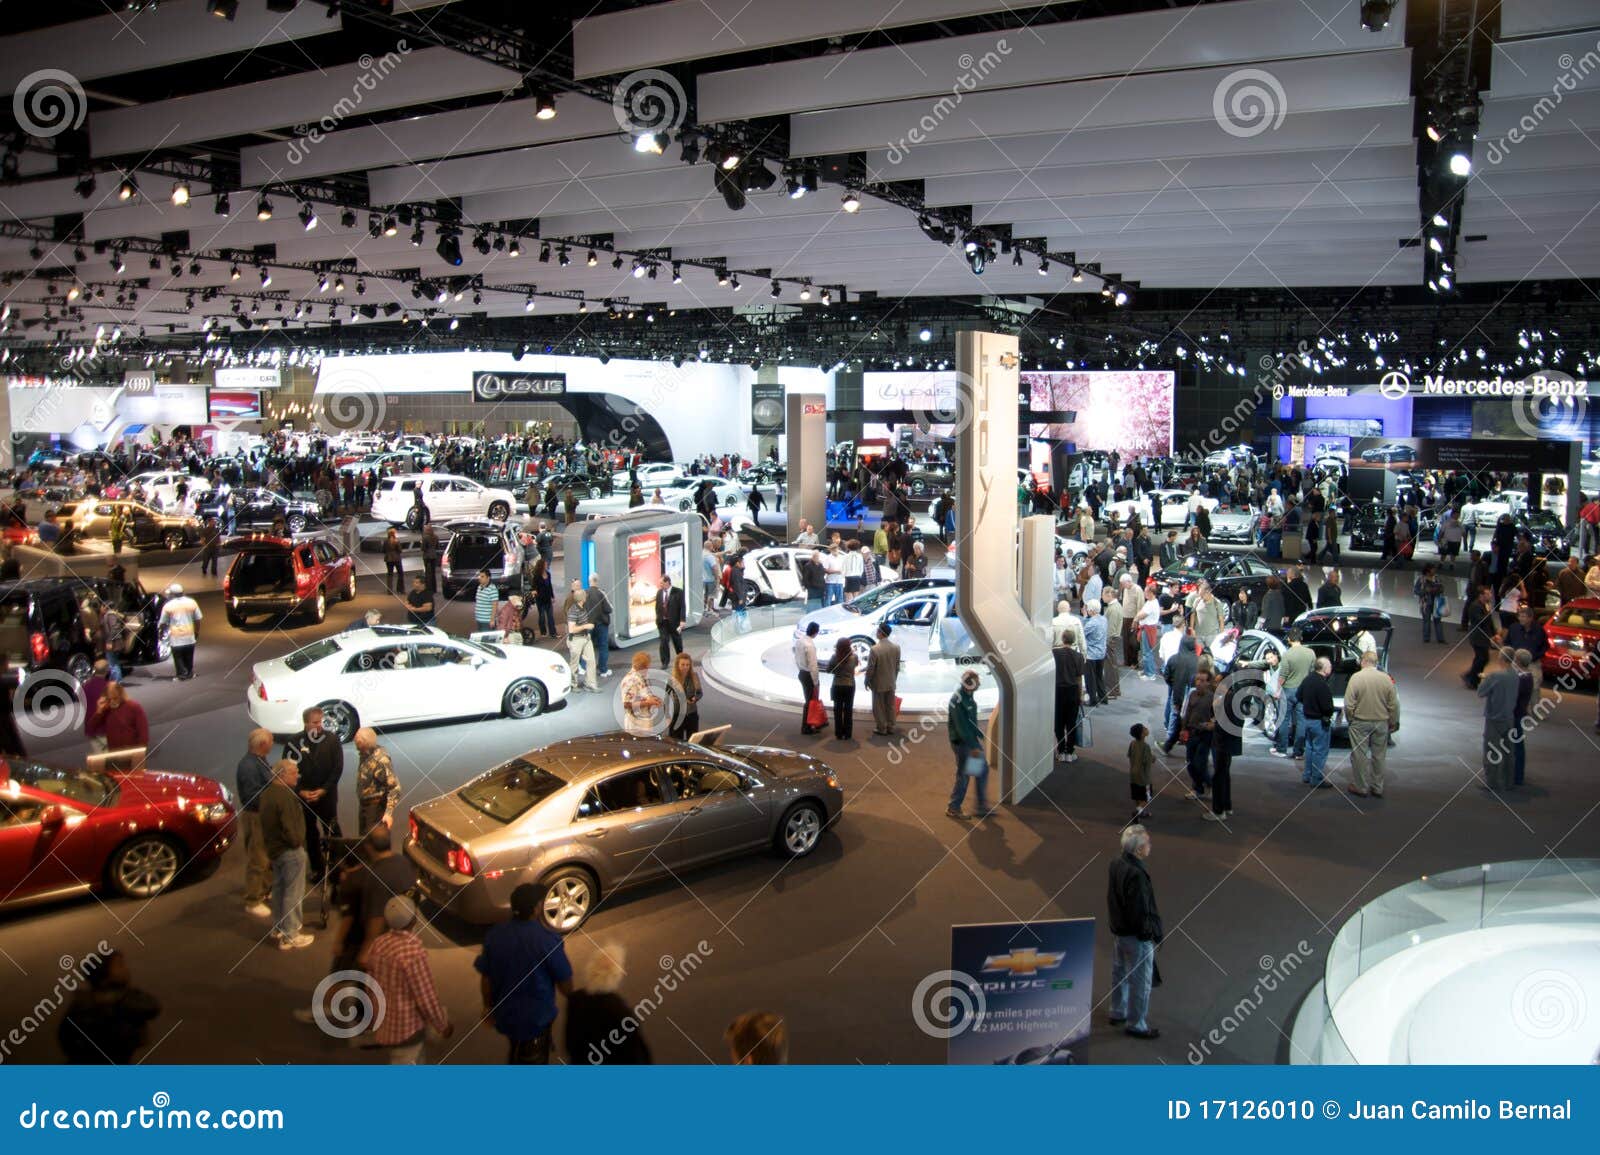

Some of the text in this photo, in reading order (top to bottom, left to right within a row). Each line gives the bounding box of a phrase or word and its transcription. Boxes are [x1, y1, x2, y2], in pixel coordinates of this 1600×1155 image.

[501, 379, 564, 394] LEXUS
[1288, 384, 1348, 397] Mercedes-Benz
[1423, 375, 1587, 395] Mercedes-Benz
[900, 387, 952, 397] LEXUS
[965, 1009, 992, 1021] More
[995, 1007, 1023, 1019] miles
[1025, 1008, 1043, 1021] per
[990, 1022, 1014, 1032] MPG
